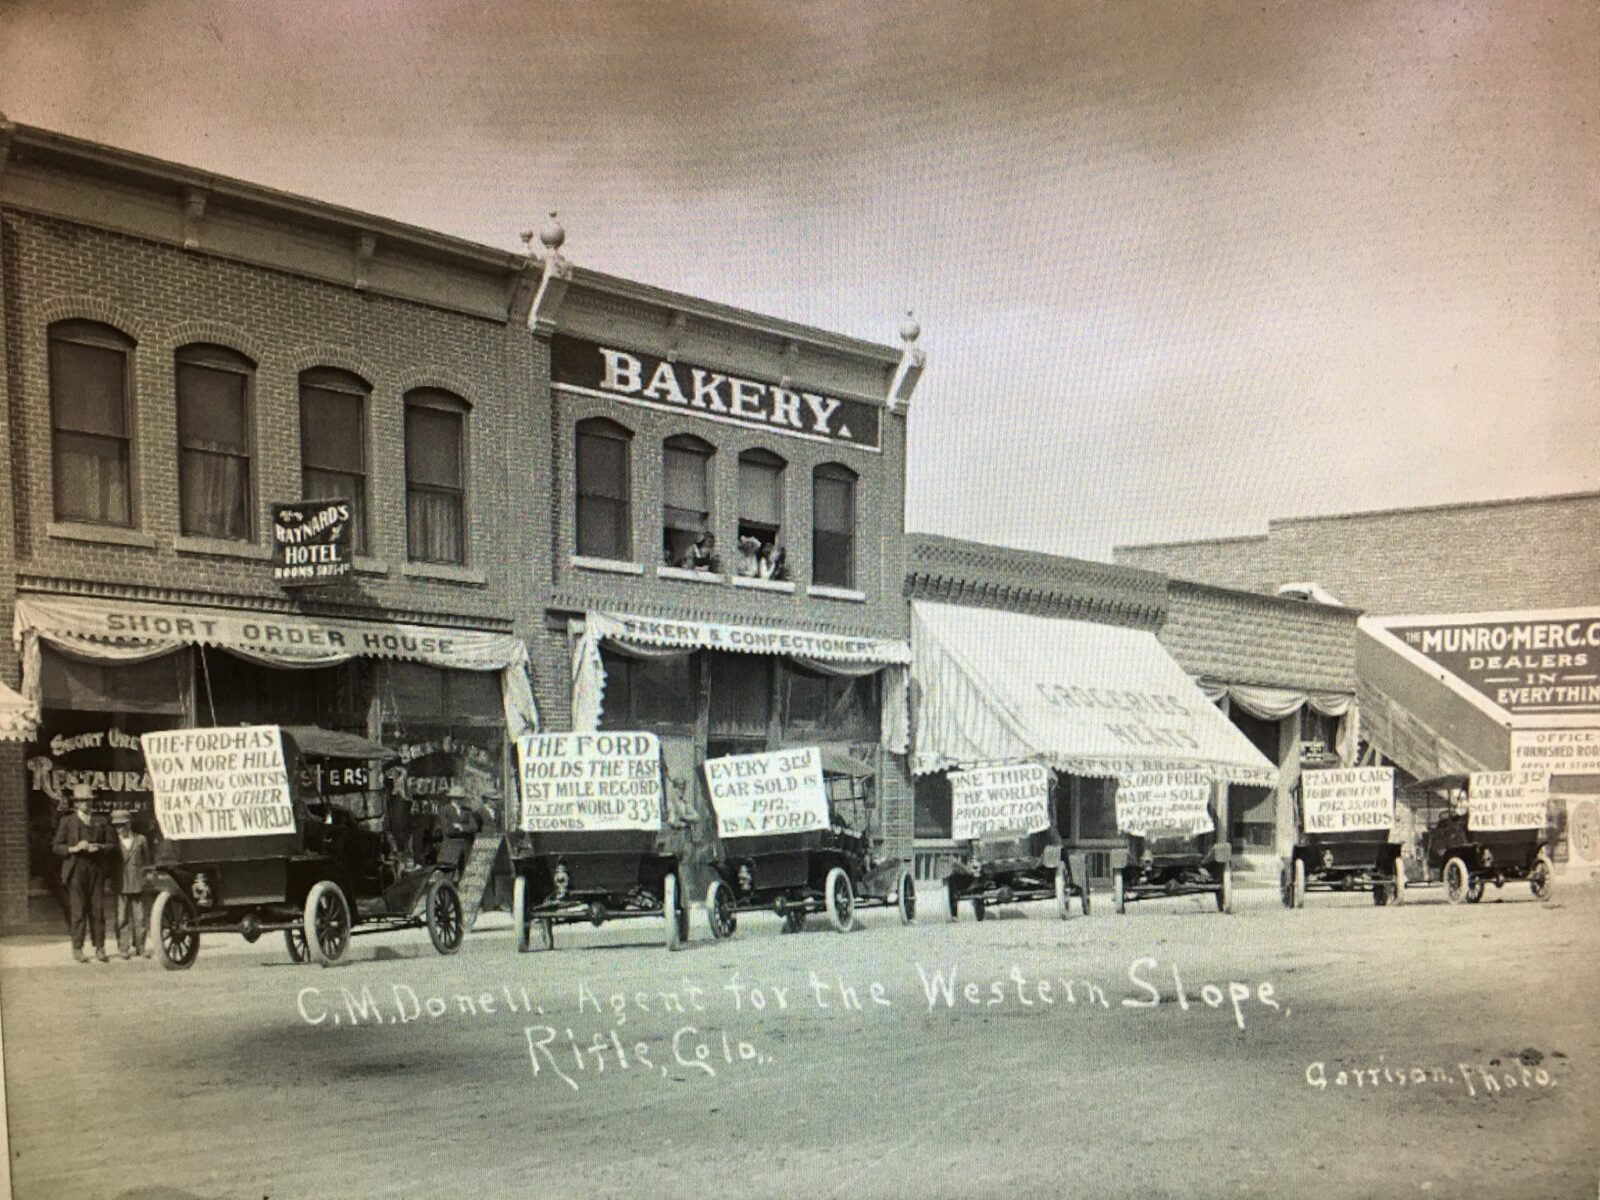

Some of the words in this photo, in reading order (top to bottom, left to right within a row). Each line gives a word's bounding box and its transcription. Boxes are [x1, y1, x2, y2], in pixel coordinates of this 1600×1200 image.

[285, 544, 341, 565] HOTEL
[105, 613, 217, 637] SHORT
[242, 623, 346, 647] ORDER
[363, 632, 455, 655] HOUSE
[624, 620, 701, 640] BAKERY
[730, 629, 877, 655] CONFECTIONERY
[1406, 631, 1421, 644] THE
[1422, 627, 1507, 653] MUNRO
[1469, 653, 1588, 670] DEALERS
[1527, 673, 1557, 684] IN
[1497, 685, 1600, 704] EVERYTHIN
[526, 737, 567, 757] THE
[577, 736, 650, 756] FORD
[1536, 733, 1595, 743] OFFICE
[190, 753, 238, 772] MORE
[243, 751, 281, 769] HILL
[525, 760, 583, 779] HOLDS
[588, 759, 625, 778] THE
[709, 760, 770, 780] EVERY
[229, 771, 288, 787] CONTESTS
[988, 768, 1042, 784] THIRD
[526, 783, 551, 799] EST
[556, 781, 595, 798] MILE
[598, 780, 659, 797] RECORD
[713, 781, 749, 798] CAR
[753, 777, 798, 795] SOLD
[196, 791, 227, 810] ANY
[232, 788, 282, 806] OTHER
[527, 802, 540, 814] IN
[547, 801, 574, 814] THE
[576, 800, 626, 816] WORLD
[188, 810, 204, 834] IN
[206, 808, 237, 832] THE
[239, 805, 291, 829] WORLD
[956, 802, 1044, 820] PRODUCTION
[1342, 812, 1393, 828] FORDS
[722, 818, 739, 833] IS
[741, 816, 756, 831] A
